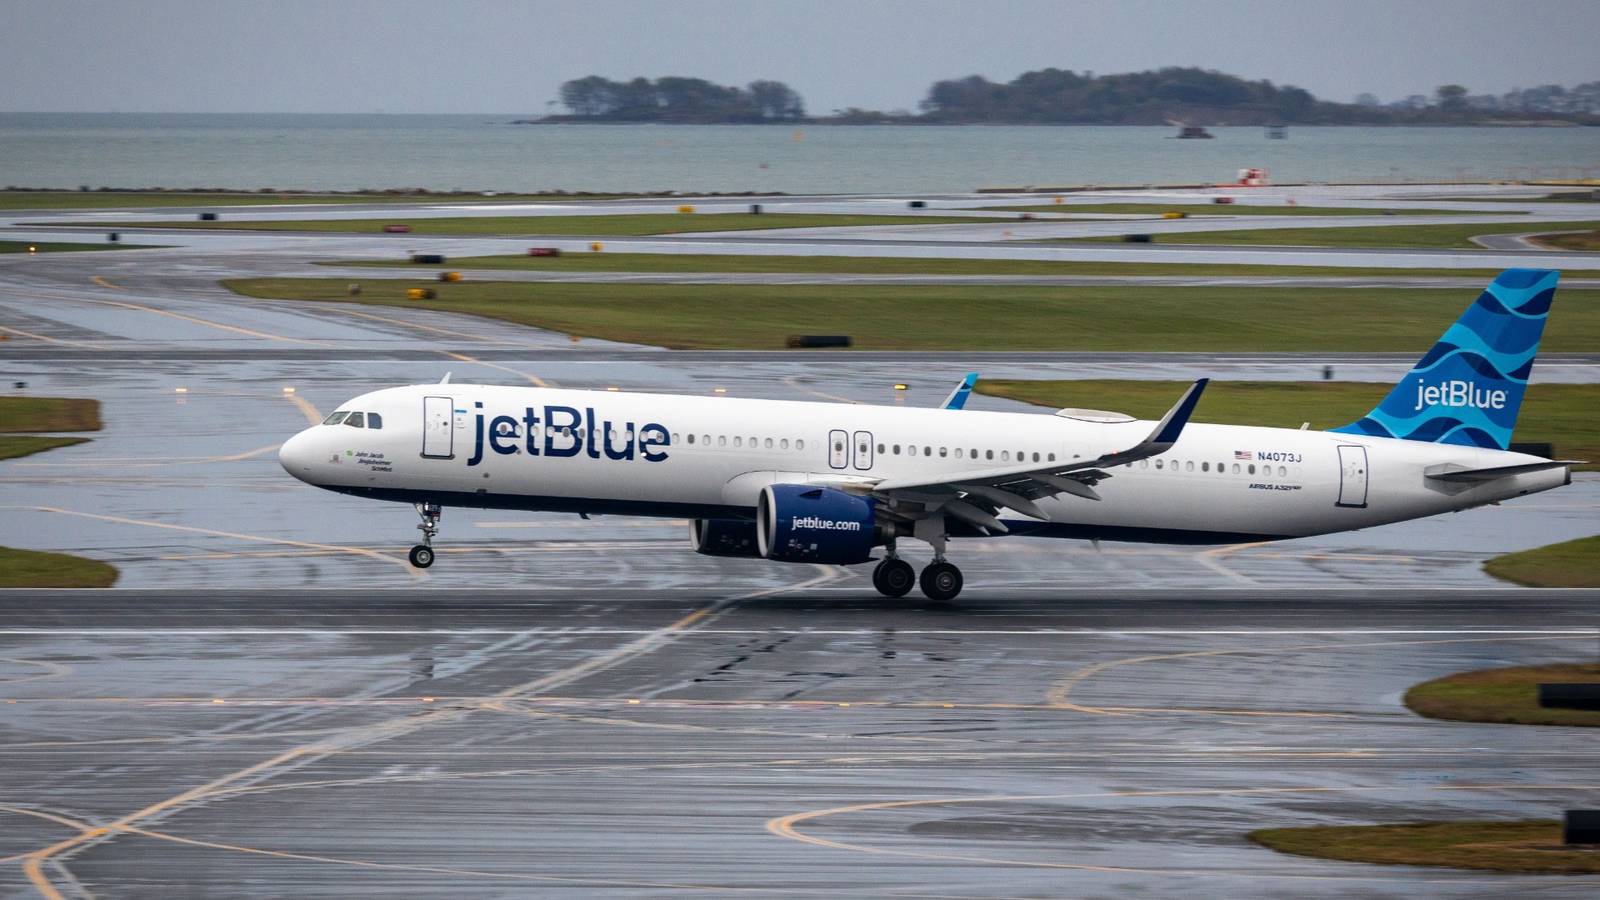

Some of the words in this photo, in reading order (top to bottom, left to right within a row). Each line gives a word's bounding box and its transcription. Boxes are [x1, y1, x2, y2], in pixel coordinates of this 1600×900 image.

[1415, 378, 1506, 411] jetBlue
[467, 401, 671, 467] jetBlue
[1257, 451, 1302, 463] N4073J
[791, 515, 861, 532] jetblue.com
